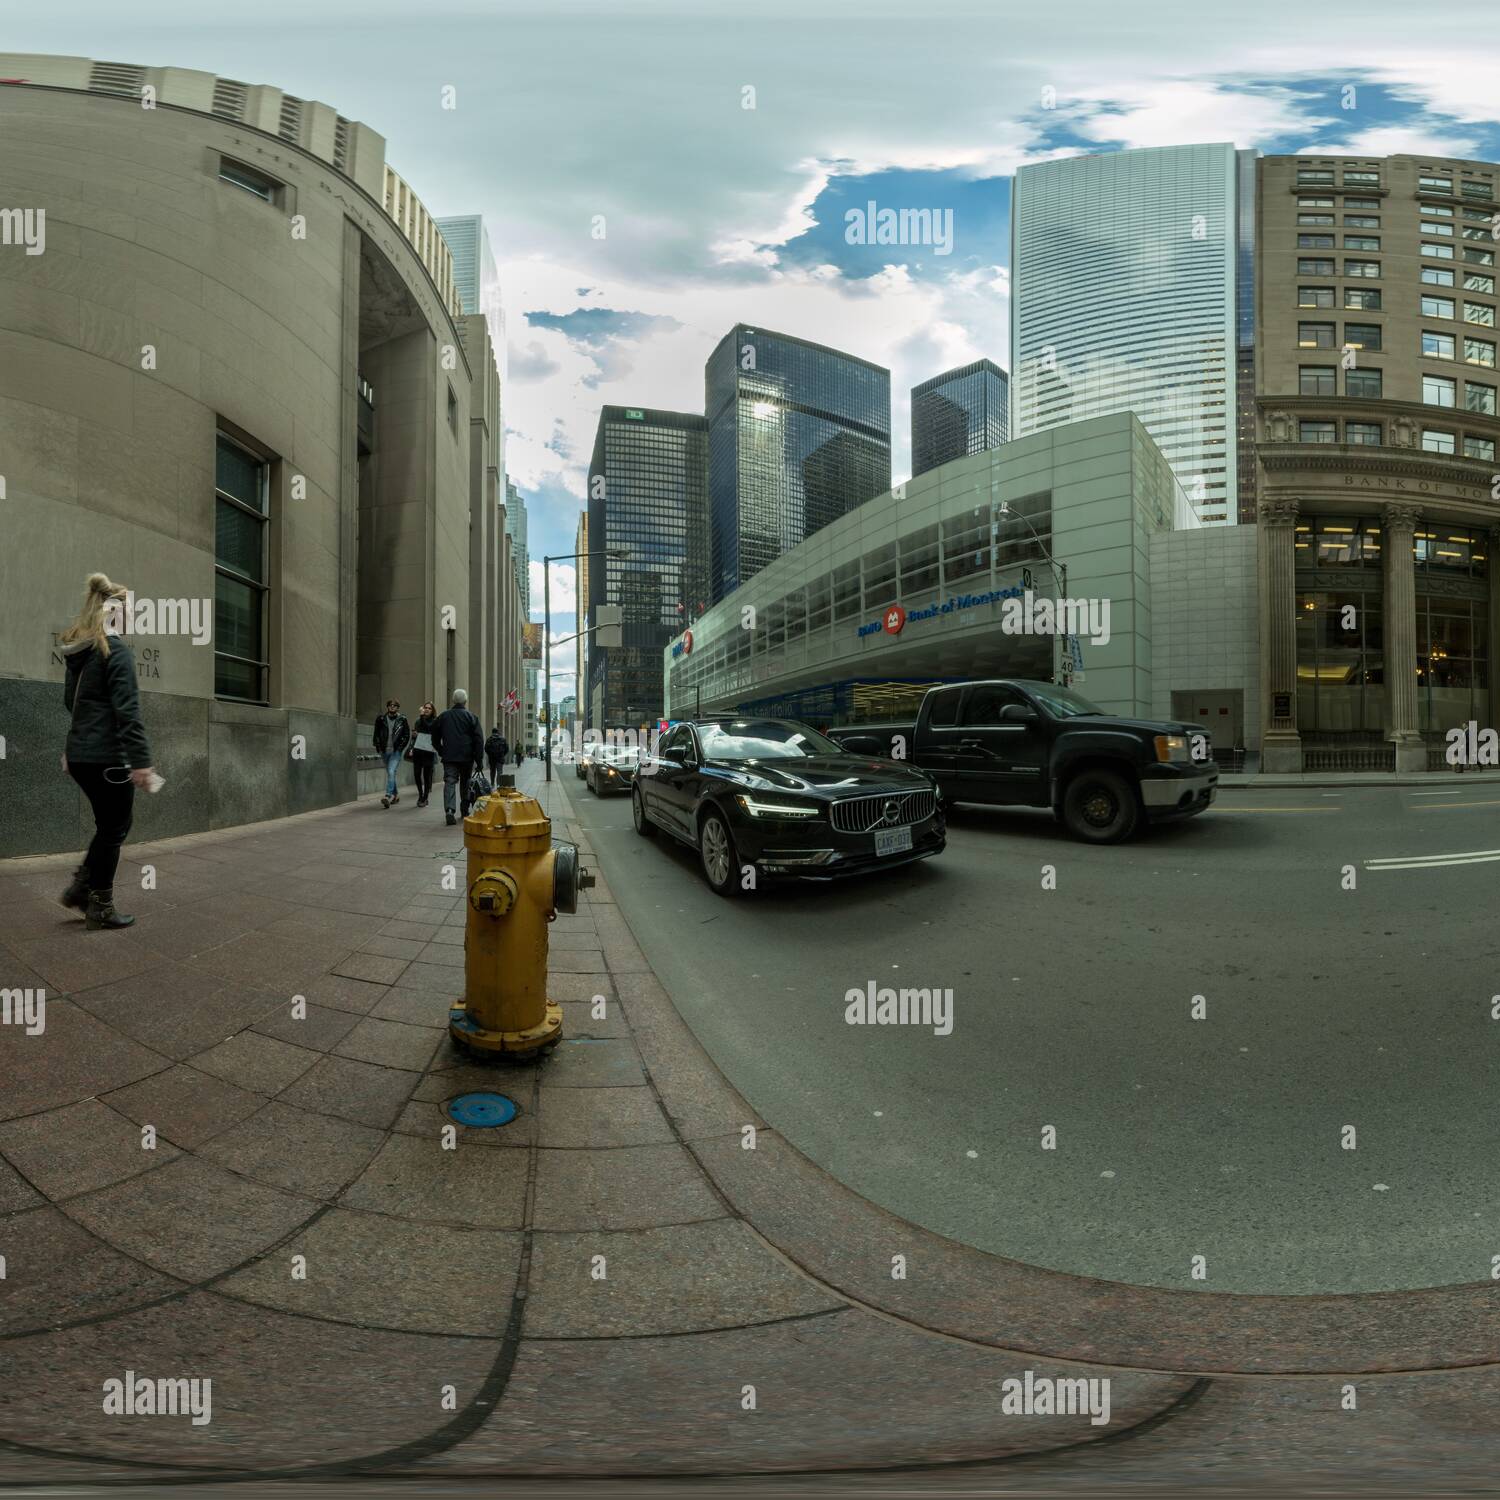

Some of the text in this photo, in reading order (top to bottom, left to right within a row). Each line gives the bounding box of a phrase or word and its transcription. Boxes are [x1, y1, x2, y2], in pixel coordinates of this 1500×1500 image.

[1344, 475, 1407, 489] BANK
[1418, 481, 1442, 493] OF
[908, 604, 939, 623] Bank
[941, 601, 954, 614] of
[1061, 662, 1074, 673] 40
